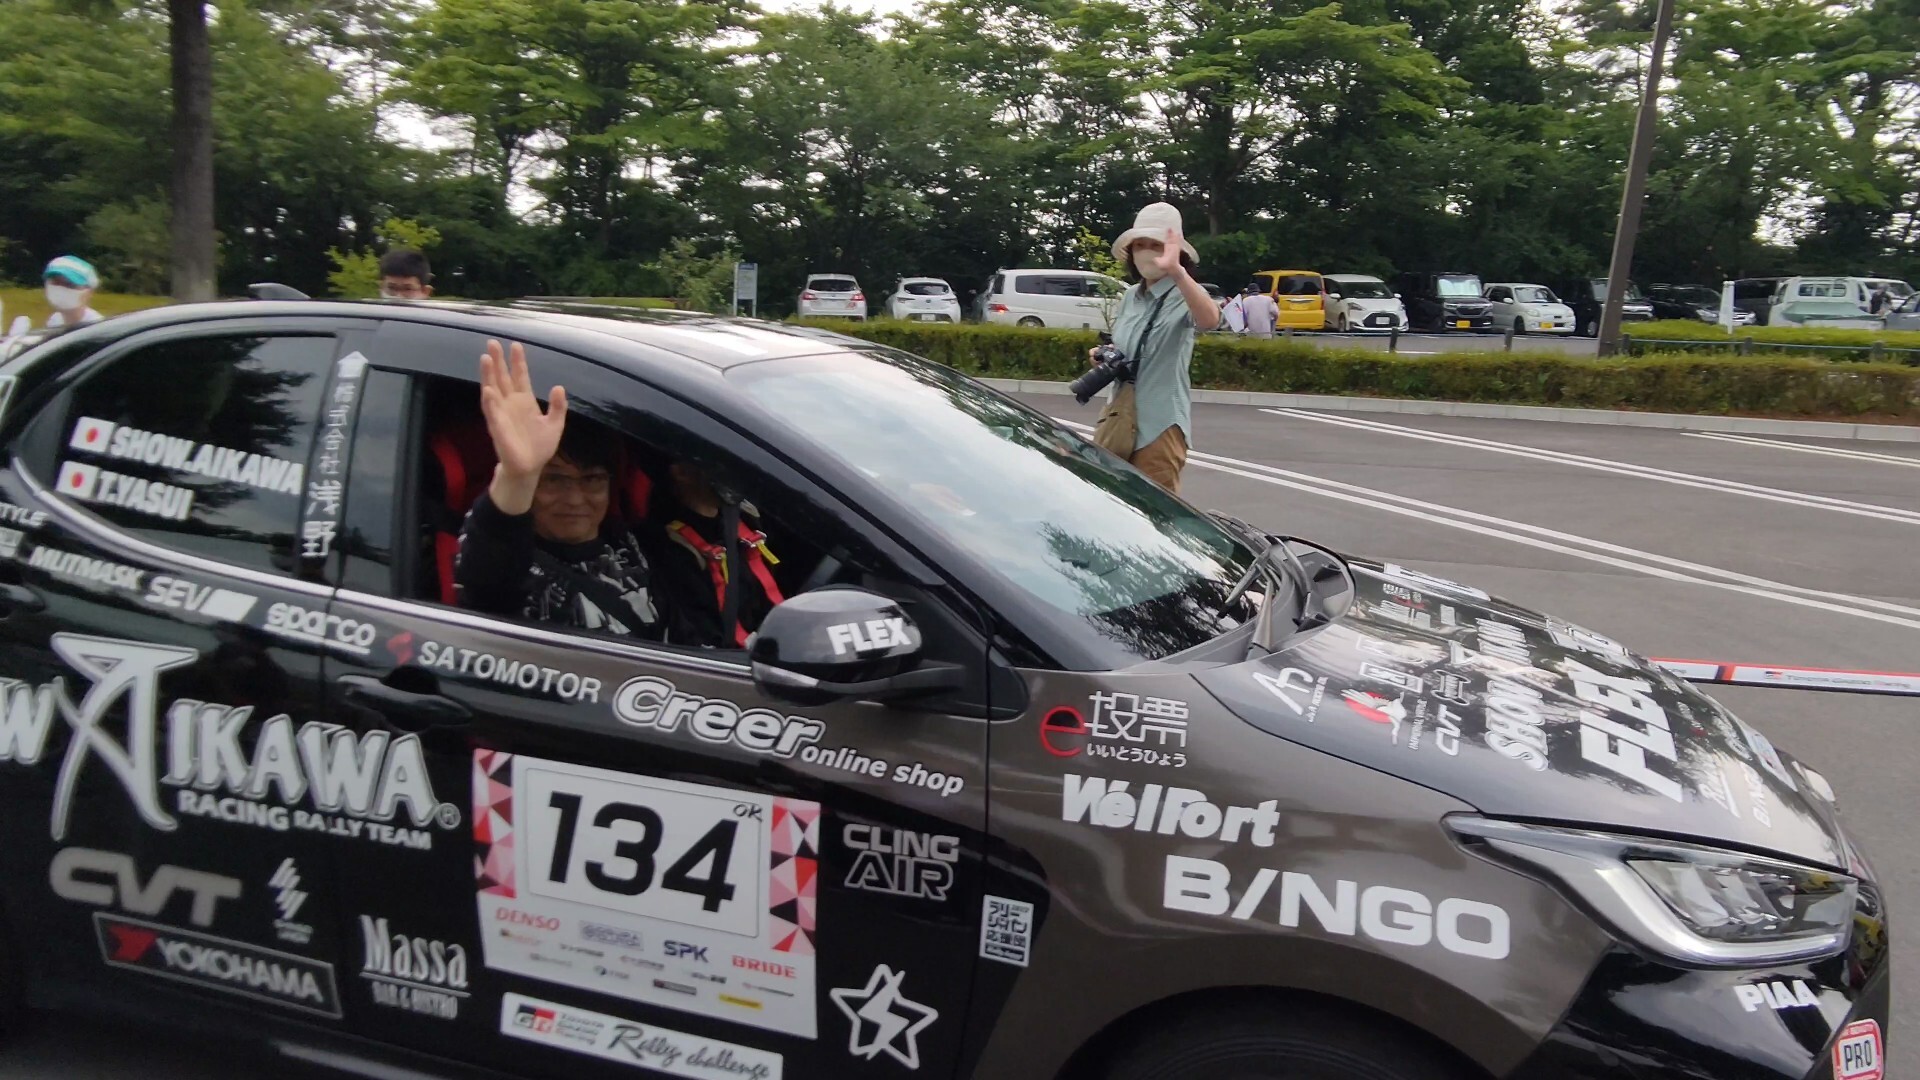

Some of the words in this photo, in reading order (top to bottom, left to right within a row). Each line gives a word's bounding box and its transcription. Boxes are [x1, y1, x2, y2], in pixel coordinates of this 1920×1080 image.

[111, 425, 304, 495] SHOW.AIKAWA
[97, 469, 195, 520] T.YASUI
[144, 576, 211, 612] SEV
[267, 602, 376, 650] sparco
[826, 617, 912, 656] FLEX
[418, 641, 602, 703] SATOMOTOR
[613, 676, 826, 759] Creer
[1435, 703, 1463, 757] CVT
[1562, 656, 1684, 803] FLEX
[801, 744, 888, 777] online
[892, 763, 965, 798] shop
[177, 789, 290, 831] RACING
[364, 822, 432, 850] TEAM
[843, 823, 960, 863] CLING
[548, 791, 740, 913] 134
[844, 850, 954, 902] AIR
[49, 846, 243, 927] CVT
[495, 906, 561, 932] DENSO
[156, 937, 325, 1003] YOKOHAMA
[358, 914, 469, 989] Massa
[663, 939, 709, 964] SPK
[731, 954, 797, 980] BRIDE
[1733, 980, 1821, 1012] PIAA
[607, 1023, 683, 1069] Rally
[1843, 1039, 1873, 1071] PRO
